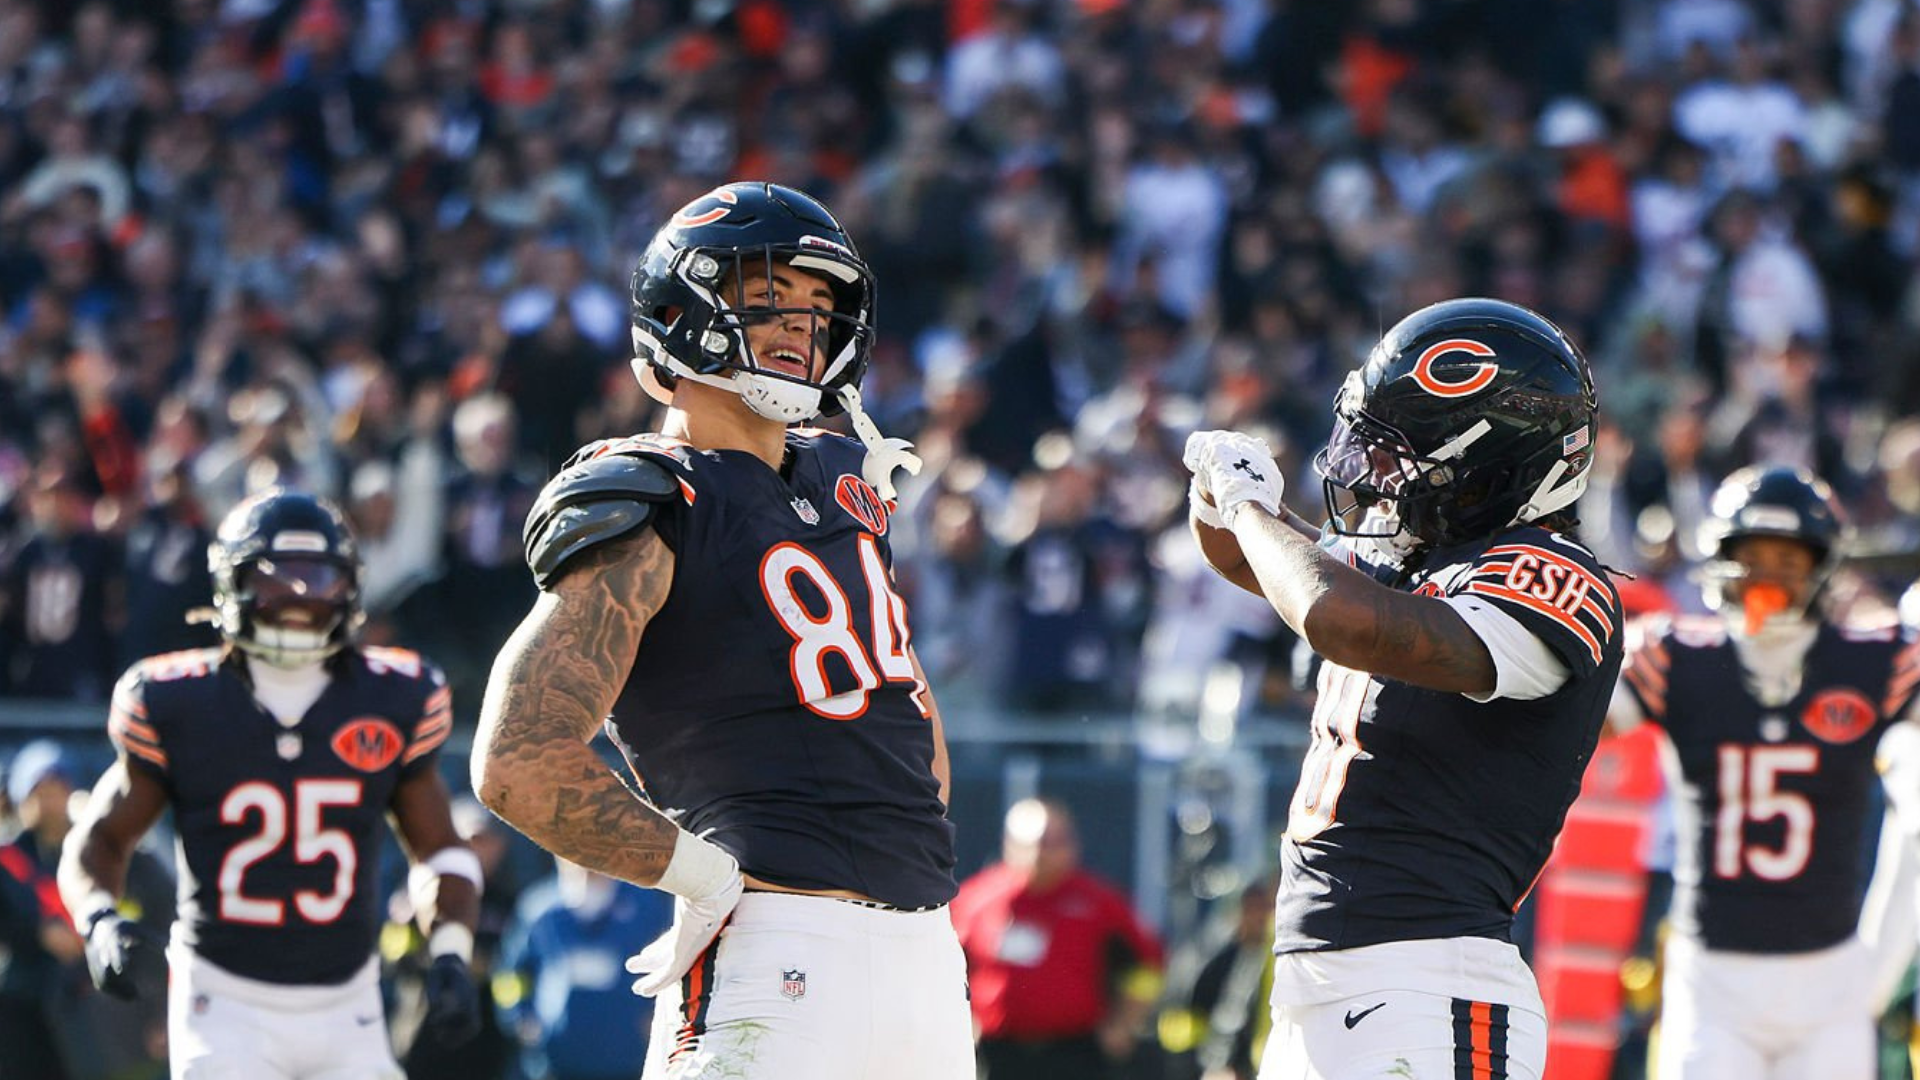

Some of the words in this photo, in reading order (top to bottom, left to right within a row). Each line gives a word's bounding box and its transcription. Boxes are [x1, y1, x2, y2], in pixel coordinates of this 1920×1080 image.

[1410, 338, 1498, 398] C
[759, 531, 932, 720] 84
[1506, 553, 1590, 616] GSH
[218, 777, 364, 926] 25
[1715, 743, 1821, 881] 15
